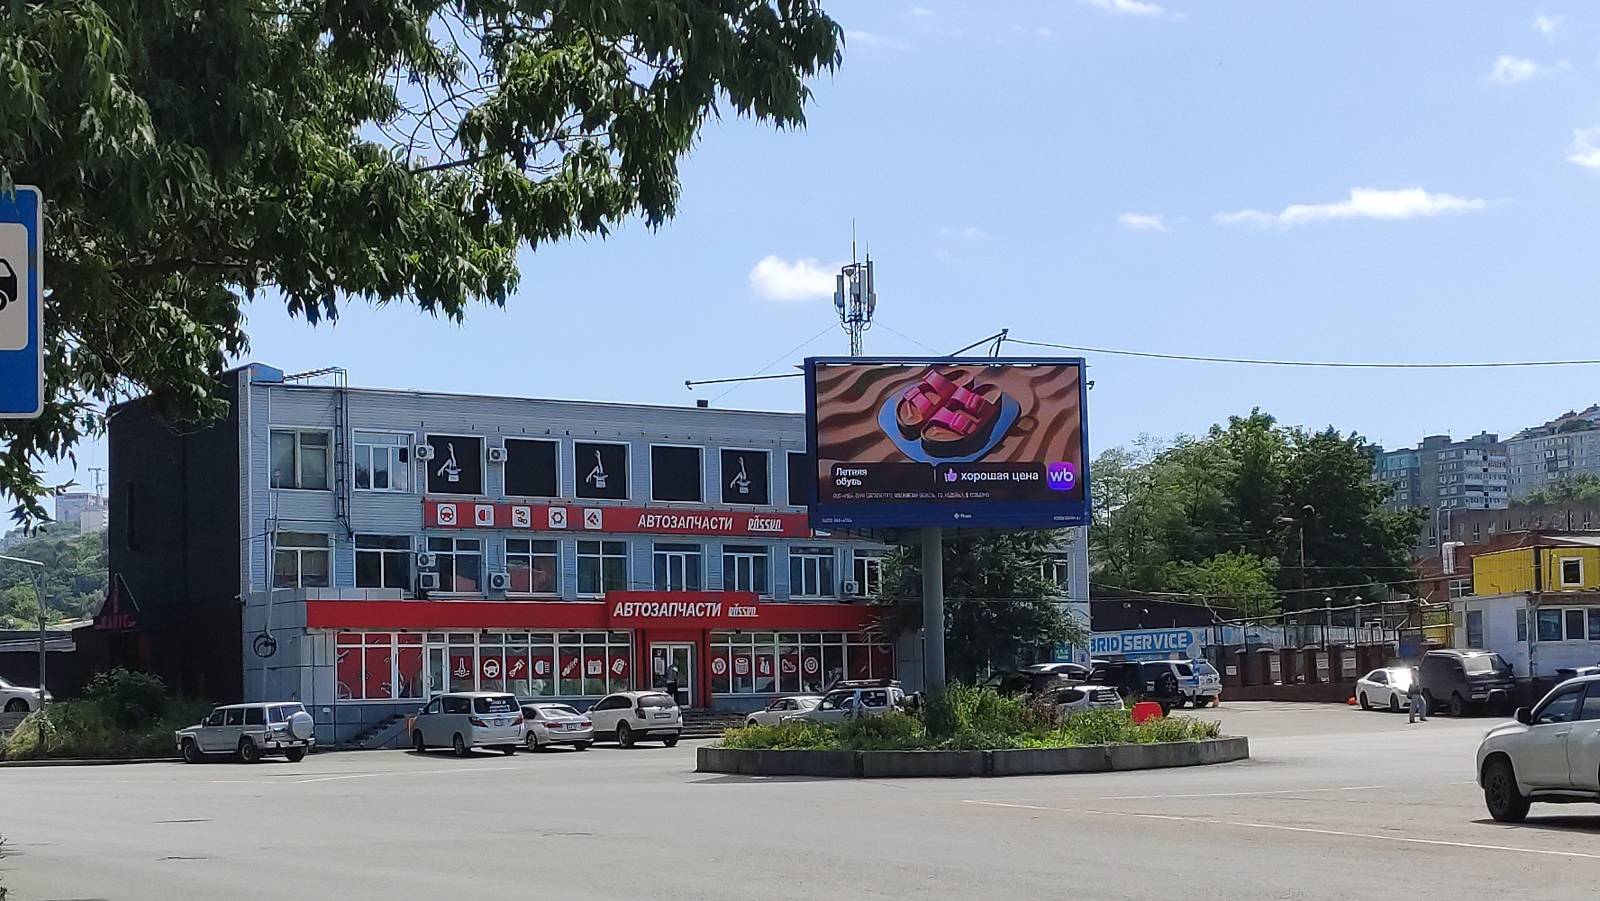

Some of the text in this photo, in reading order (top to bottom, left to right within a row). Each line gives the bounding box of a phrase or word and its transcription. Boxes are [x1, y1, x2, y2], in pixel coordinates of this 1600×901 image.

[835, 467, 868, 477] Летняя
[961, 471, 1039, 483] хорошая цена
[1050, 467, 1074, 482] wb
[835, 477, 862, 488] обувь
[637, 514, 733, 530] АВТОЗАПЧАСТИ
[613, 601, 722, 617] АВТОЗАПЧАСТИ
[1123, 632, 1187, 651] SERVICE
